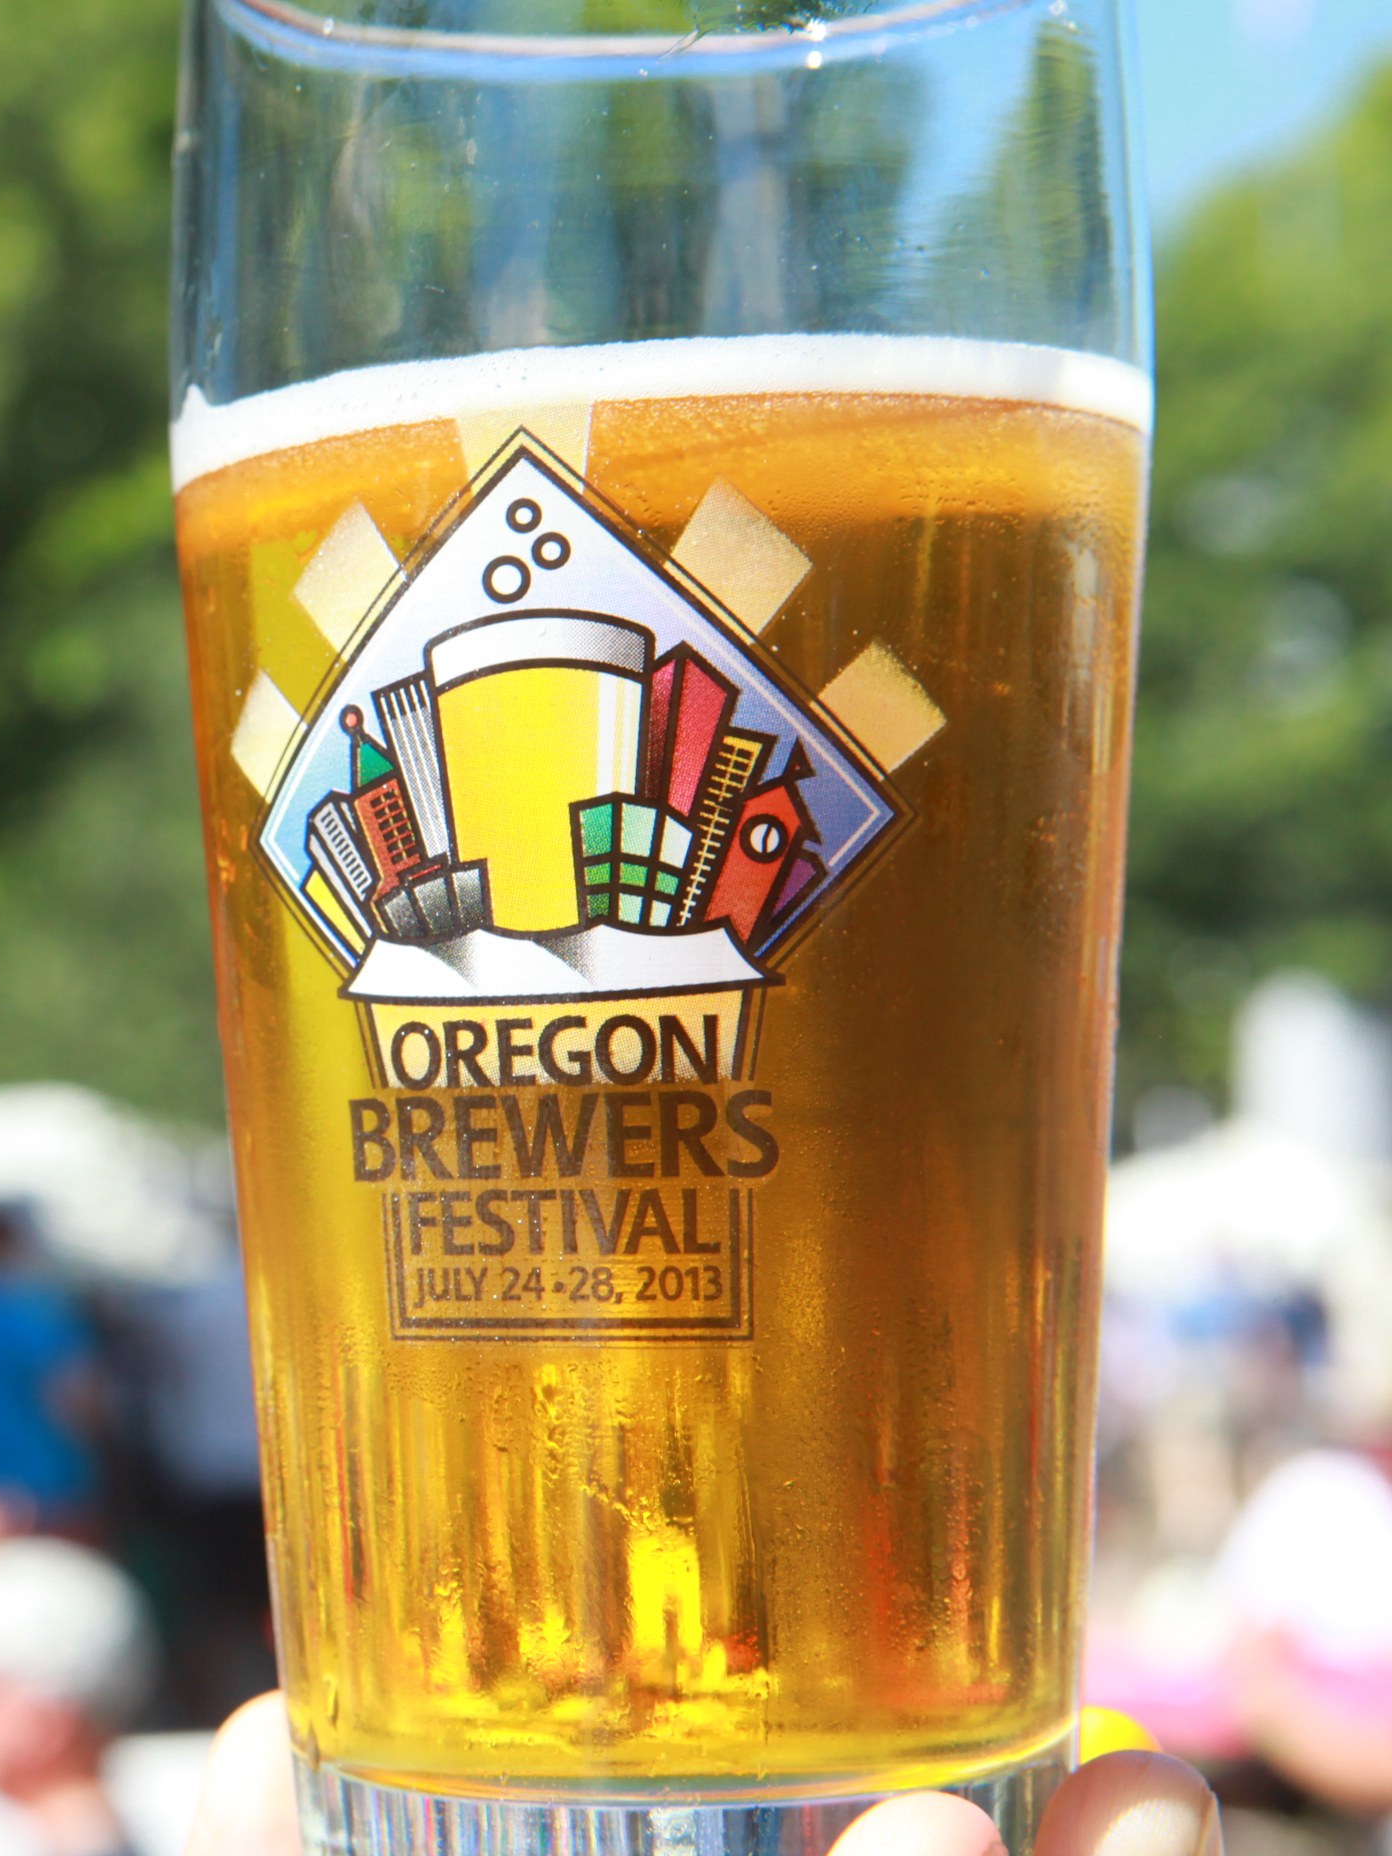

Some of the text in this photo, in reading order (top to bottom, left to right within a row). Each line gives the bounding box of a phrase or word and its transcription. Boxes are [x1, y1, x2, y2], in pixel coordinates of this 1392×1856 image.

[391, 1014, 719, 1090] OREGON
[349, 1089, 779, 1181] BREWERS
[410, 1188, 721, 1256] FESTIVAL
[414, 1266, 488, 1307] JULY
[635, 1265, 723, 1301] 2013
